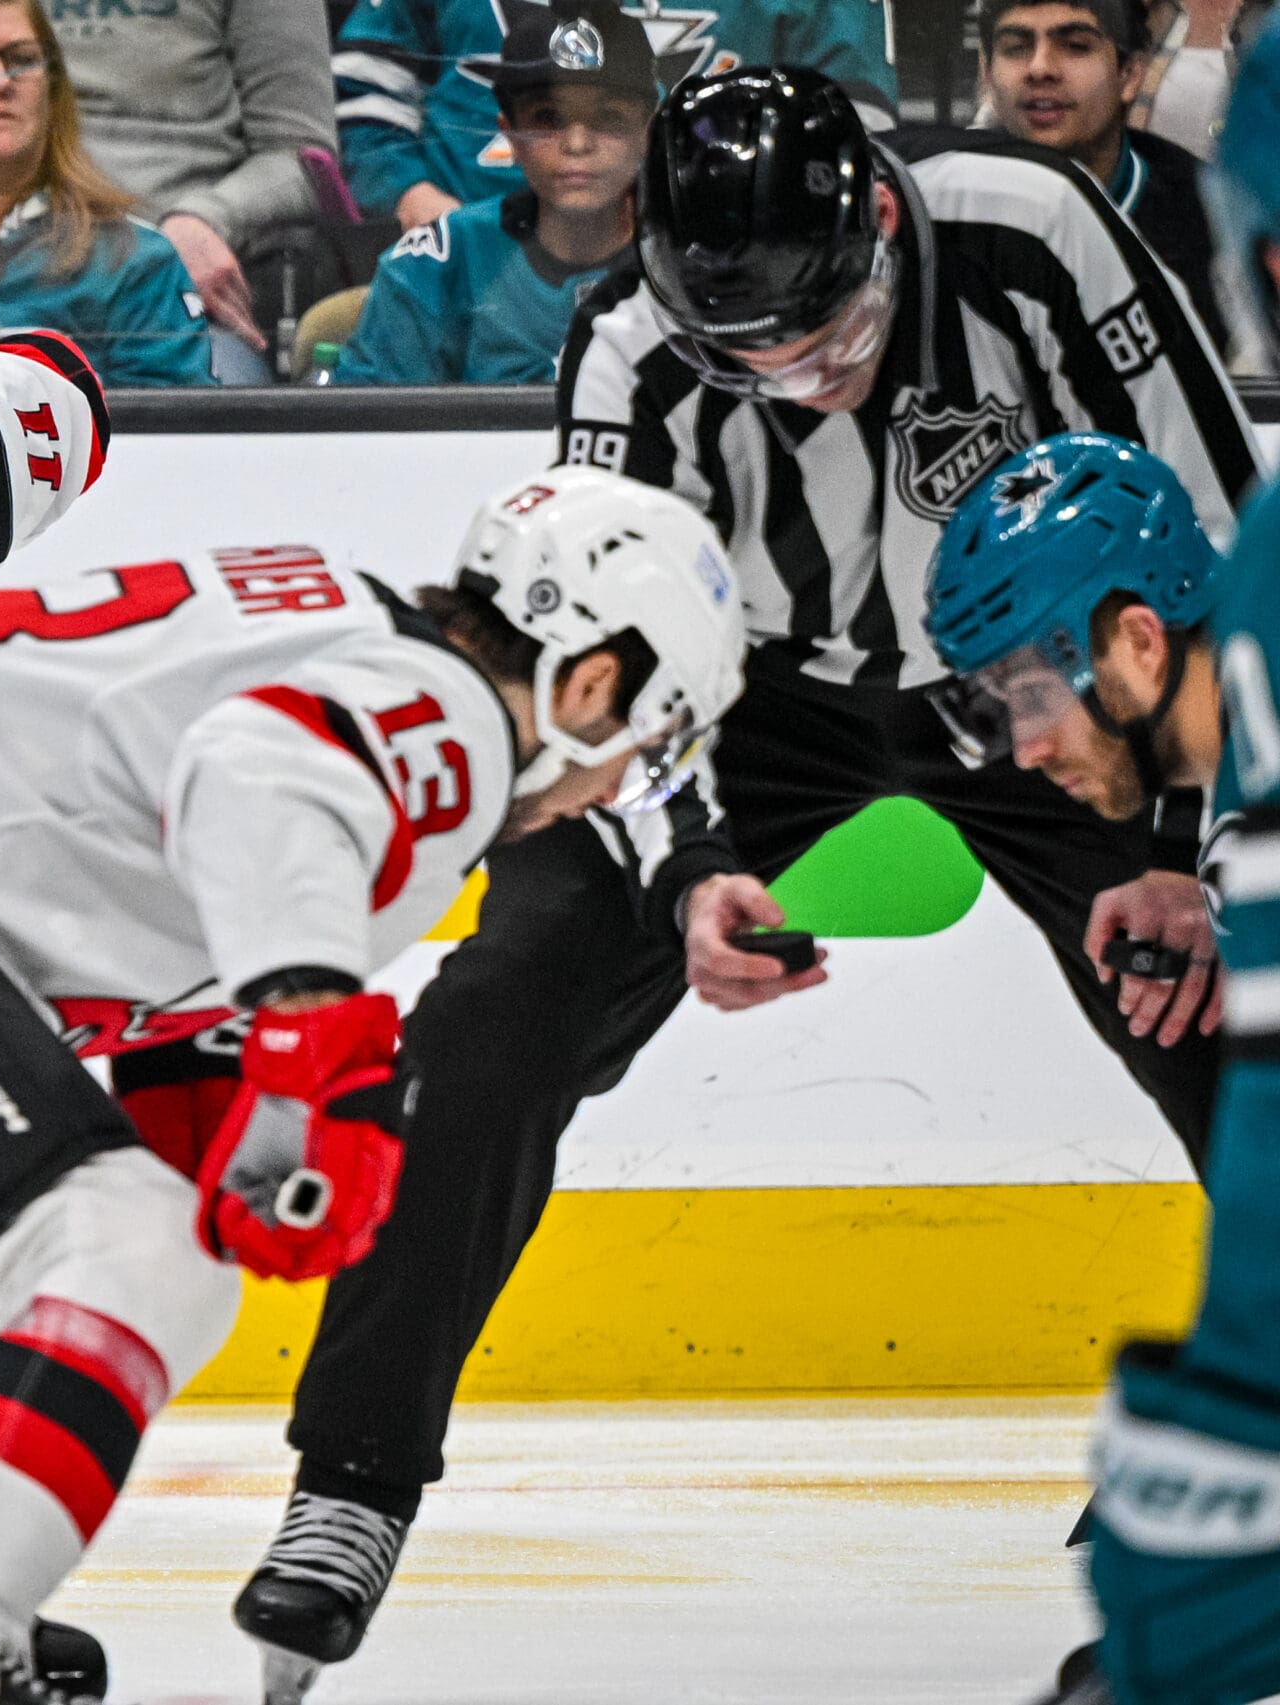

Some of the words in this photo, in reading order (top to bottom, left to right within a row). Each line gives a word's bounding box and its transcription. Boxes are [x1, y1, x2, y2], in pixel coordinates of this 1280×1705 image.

[1095, 299, 1158, 373] 89
[13, 402, 63, 491] 11
[566, 428, 629, 473] 89
[930, 432, 1002, 502] NHL
[365, 690, 472, 843] 13
